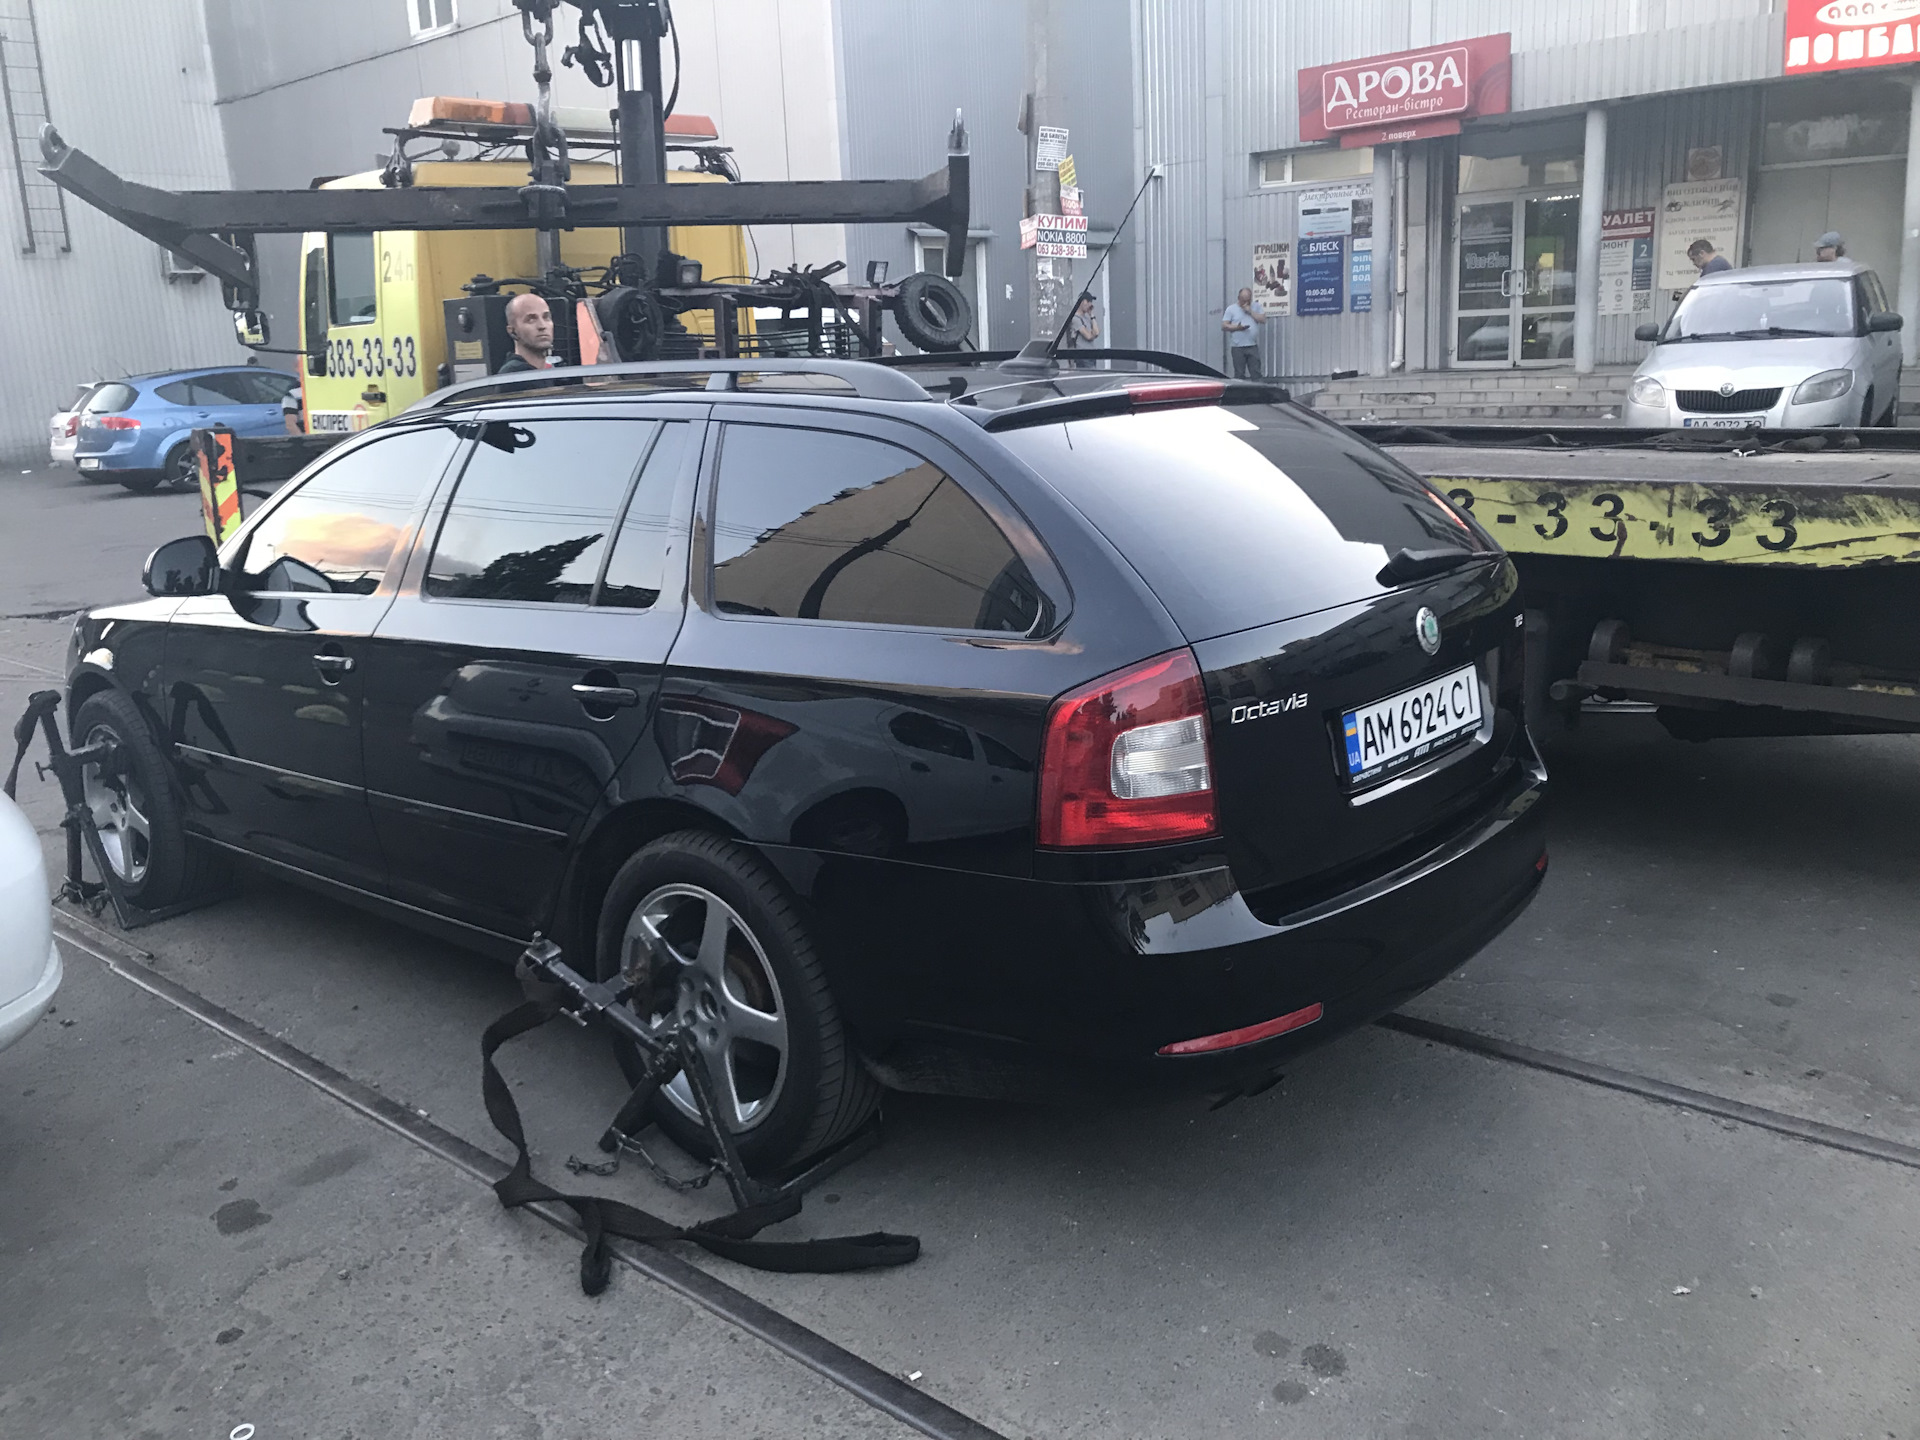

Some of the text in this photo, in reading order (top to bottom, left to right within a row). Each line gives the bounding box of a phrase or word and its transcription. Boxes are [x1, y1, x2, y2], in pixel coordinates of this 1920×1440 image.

[1787, 23, 1920, 67] ЛОМБА
[1327, 56, 1463, 113] ДРОВА
[1345, 96, 1443, 120] Ресторан-бістро
[1381, 129, 1416, 141] 2 поверх
[1038, 215, 1087, 230] КУПИМ
[1602, 211, 1655, 227] УАЛЕТ
[1037, 231, 1064, 243] NOKIA
[1065, 232, 1086, 244] 8800
[1037, 243, 1086, 257] 063 238-38-11
[1254, 243, 1290, 254] ІГРАШКИ
[1309, 241, 1339, 252] БЛЕСК
[1640, 244, 1648, 257] 2
[1352, 264, 1371, 273] ДЛЯ
[327, 336, 417, 378] 383-33-33
[312, 414, 349, 431] ЕКСПРЕС
[1231, 693, 1308, 724] Octavia
[1348, 751, 1360, 767] UA
